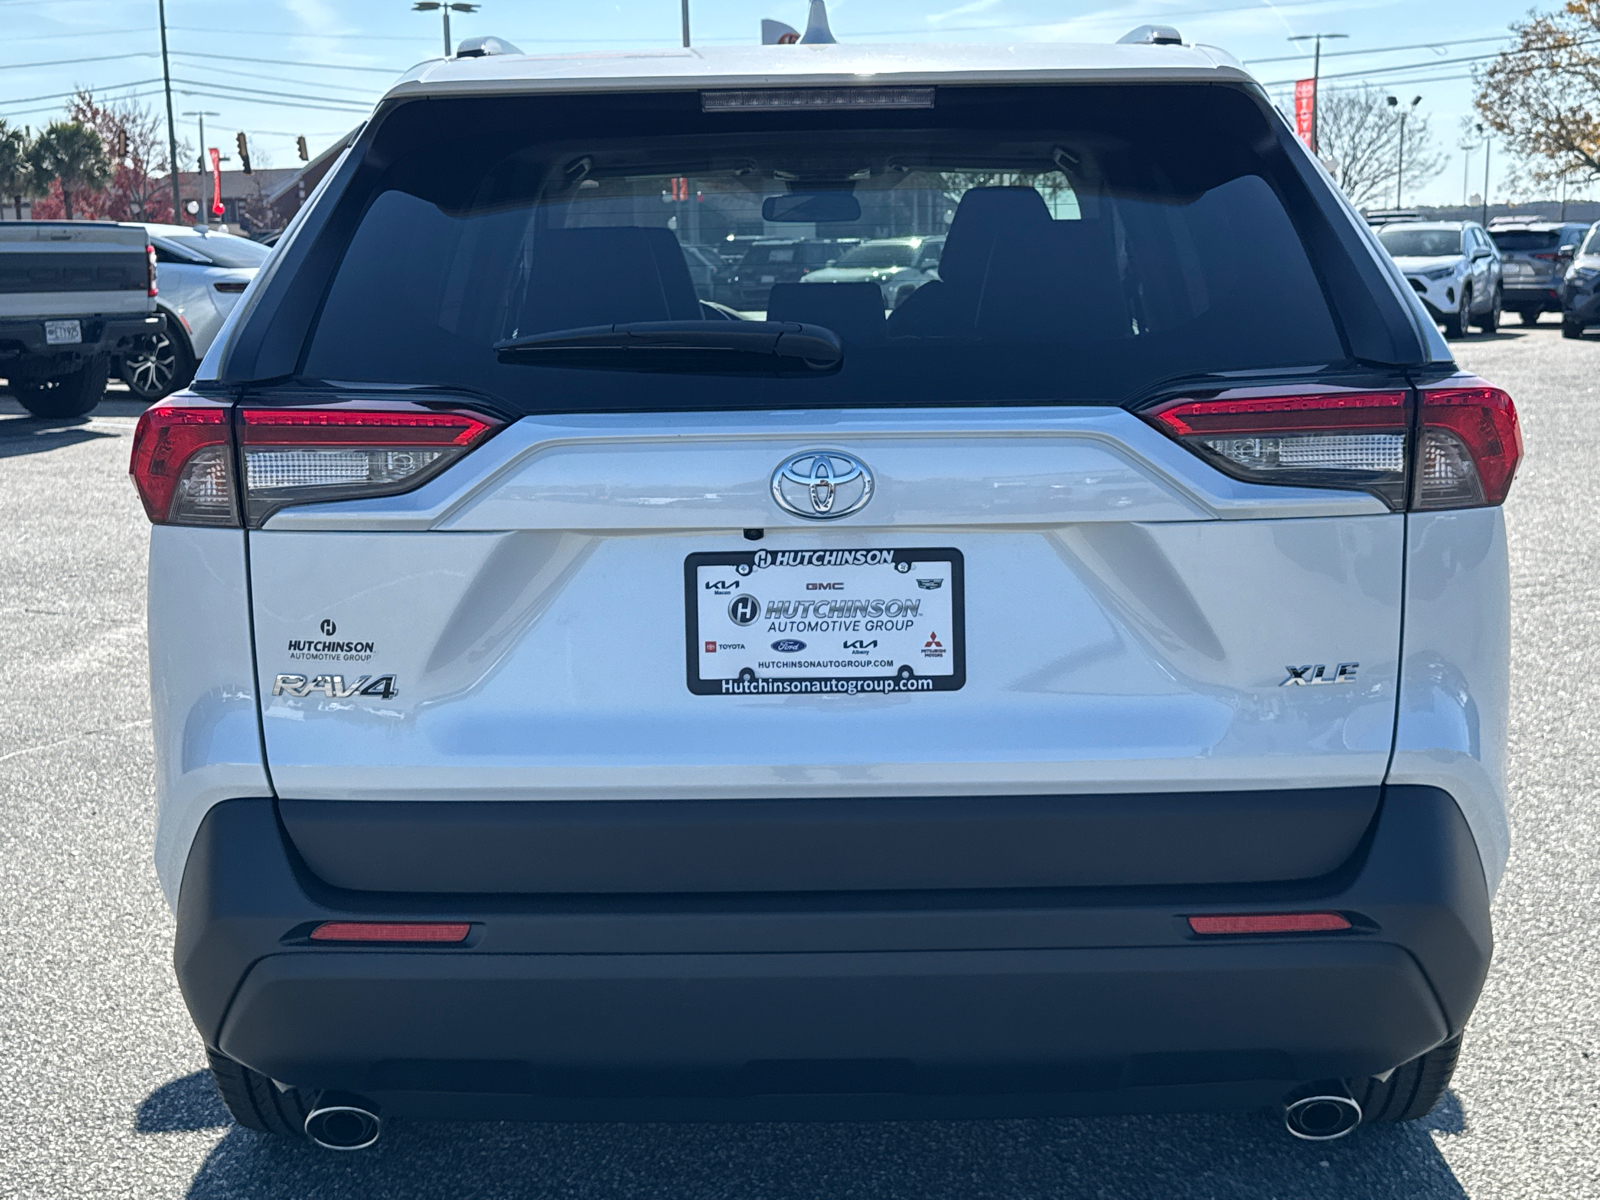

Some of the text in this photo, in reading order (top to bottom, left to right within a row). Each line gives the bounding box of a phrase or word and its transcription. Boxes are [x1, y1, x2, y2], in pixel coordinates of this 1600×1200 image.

[775, 550, 894, 566] HUTCHINSON
[705, 580, 740, 590] KIA
[806, 582, 845, 591] GMC
[764, 599, 921, 620] HUTCHINSON
[767, 620, 914, 632] AUTOMOTIVE GROUP
[287, 640, 375, 653] HUTCHINSON
[719, 643, 746, 651] TOYOTA
[778, 640, 801, 651] Ford
[843, 640, 878, 649] KIA
[290, 652, 372, 662] AUTOMOTIVE GROUP
[757, 660, 894, 669] HUTCHINSONAUTOGROUP.COM
[1278, 662, 1360, 687] XLE
[271, 673, 399, 700] RAV4
[721, 678, 933, 695] Hutchinsonautogroup.com
